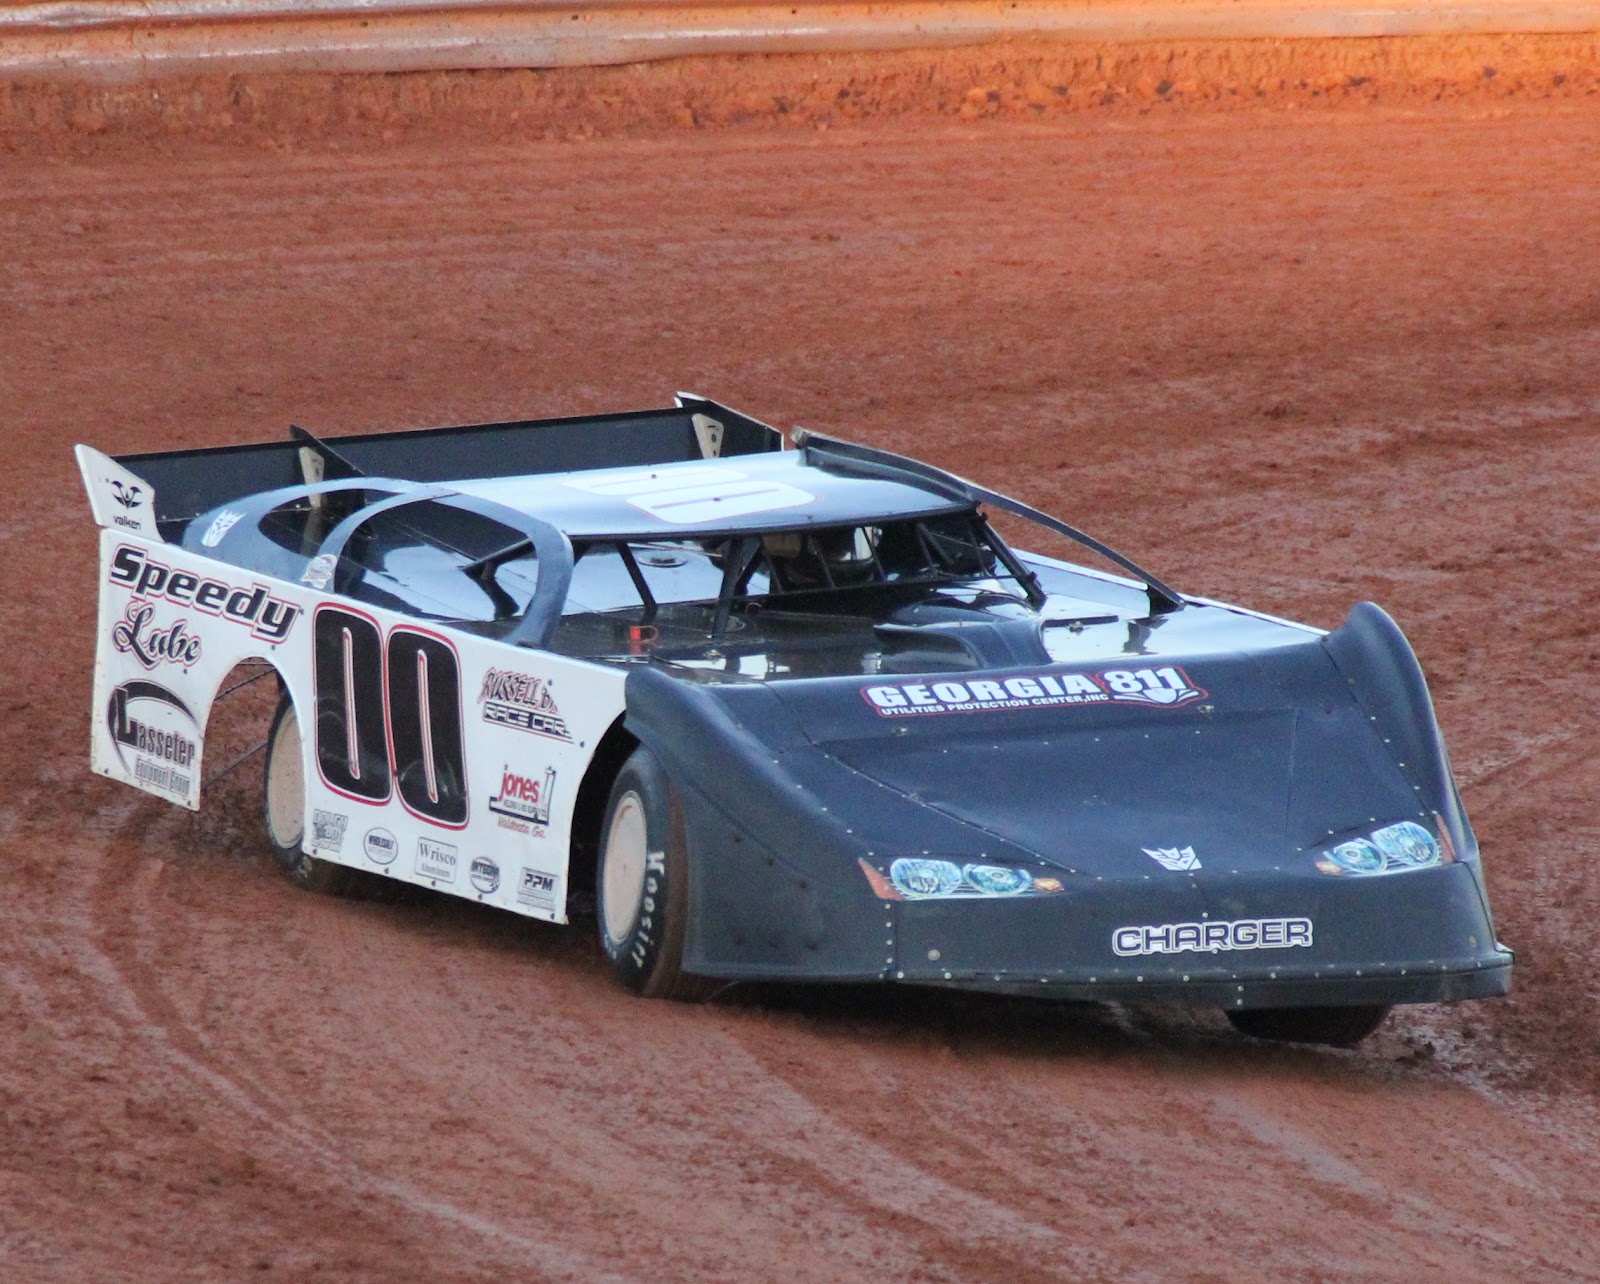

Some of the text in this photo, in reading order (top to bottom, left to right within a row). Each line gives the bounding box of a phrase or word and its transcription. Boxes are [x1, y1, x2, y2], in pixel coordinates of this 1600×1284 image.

[110, 544, 299, 643] Speedy
[112, 601, 201, 671] Lube
[867, 667, 1187, 708] GEORGIA 811
[881, 705, 946, 716] UTILITIES
[948, 699, 1030, 712] PROTECTION
[115, 686, 195, 769] Lasseter
[312, 602, 470, 830] 00
[484, 704, 530, 728] RACE
[498, 764, 540, 803] jones
[419, 842, 456, 866] Wrisco
[524, 873, 554, 892] PPM
[1112, 917, 1313, 957] CHARGER
